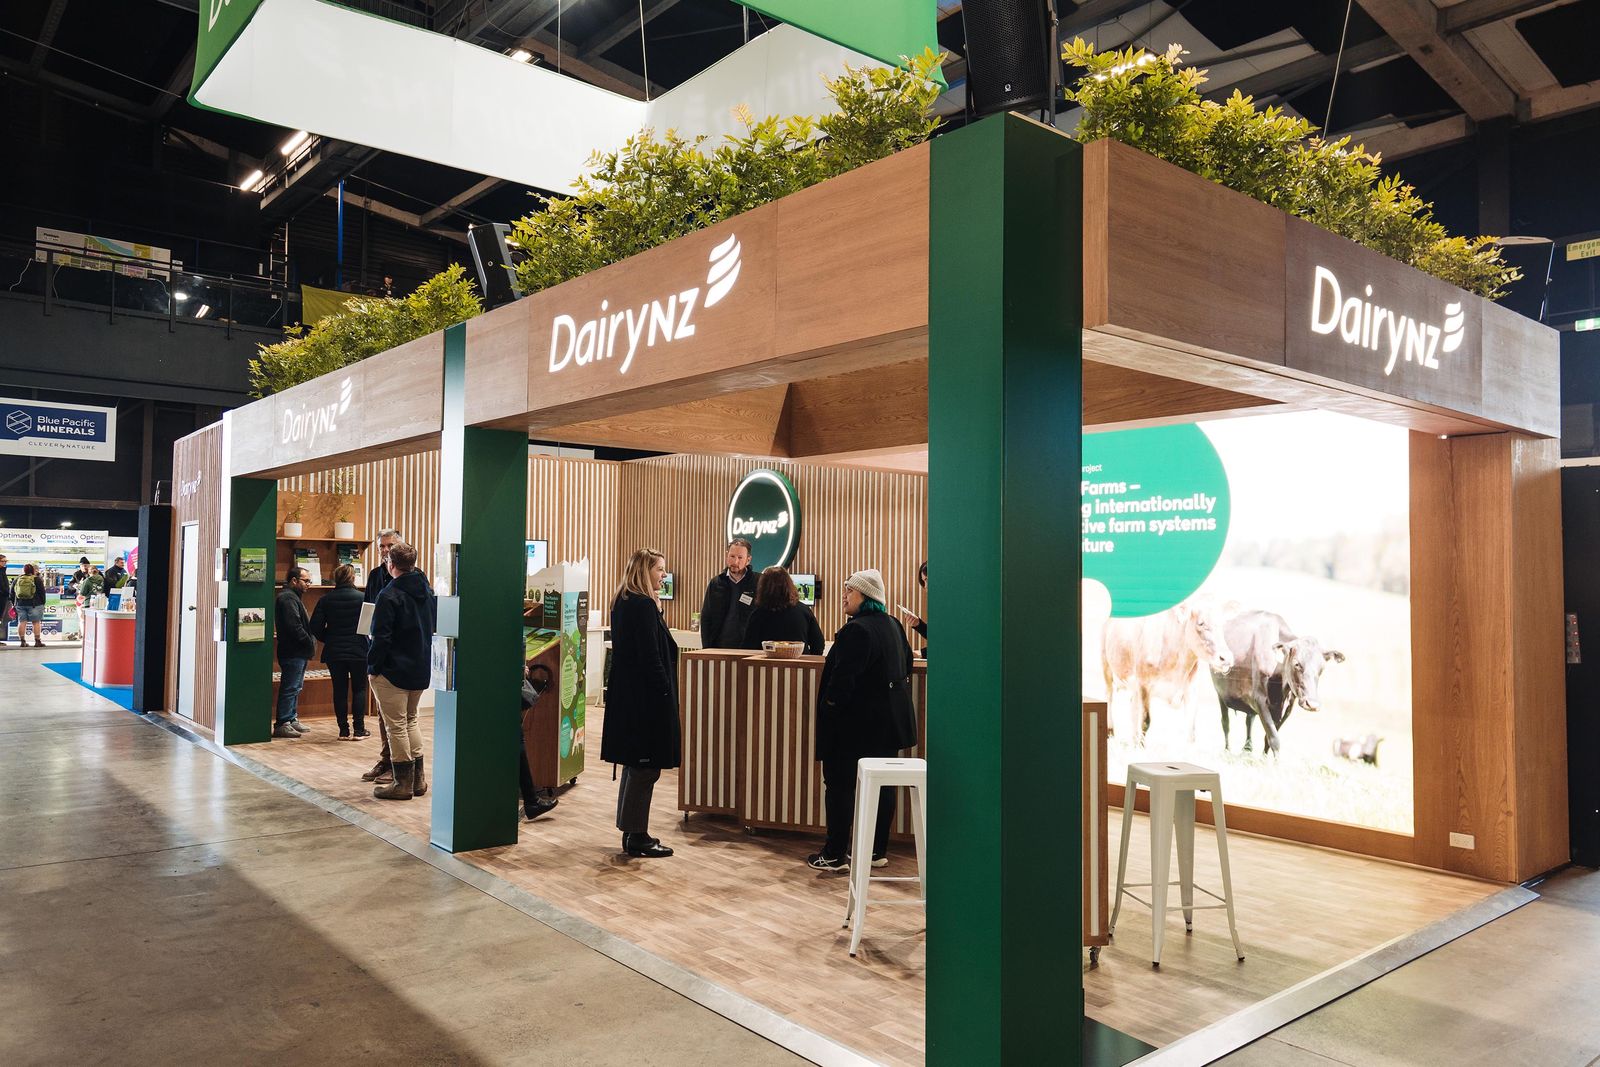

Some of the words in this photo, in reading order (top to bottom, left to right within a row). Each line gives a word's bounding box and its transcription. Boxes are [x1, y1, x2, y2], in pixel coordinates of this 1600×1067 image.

[548, 287, 700, 375] DairyNZ
[1311, 265, 1441, 376] DairyNZ
[37, 415, 60, 425] Blue
[62, 417, 96, 428] Pacific
[37, 424, 96, 436] MINERALS
[282, 402, 338, 449] DairyNZ
[1082, 464, 1103, 474] roject
[1081, 480, 1127, 496] Farms
[1095, 493, 1217, 514] internationally
[732, 517, 778, 539] DairyNZ
[1108, 517, 1146, 533] farm
[1148, 515, 1217, 536] systems
[40, 533, 75, 541] Optimate
